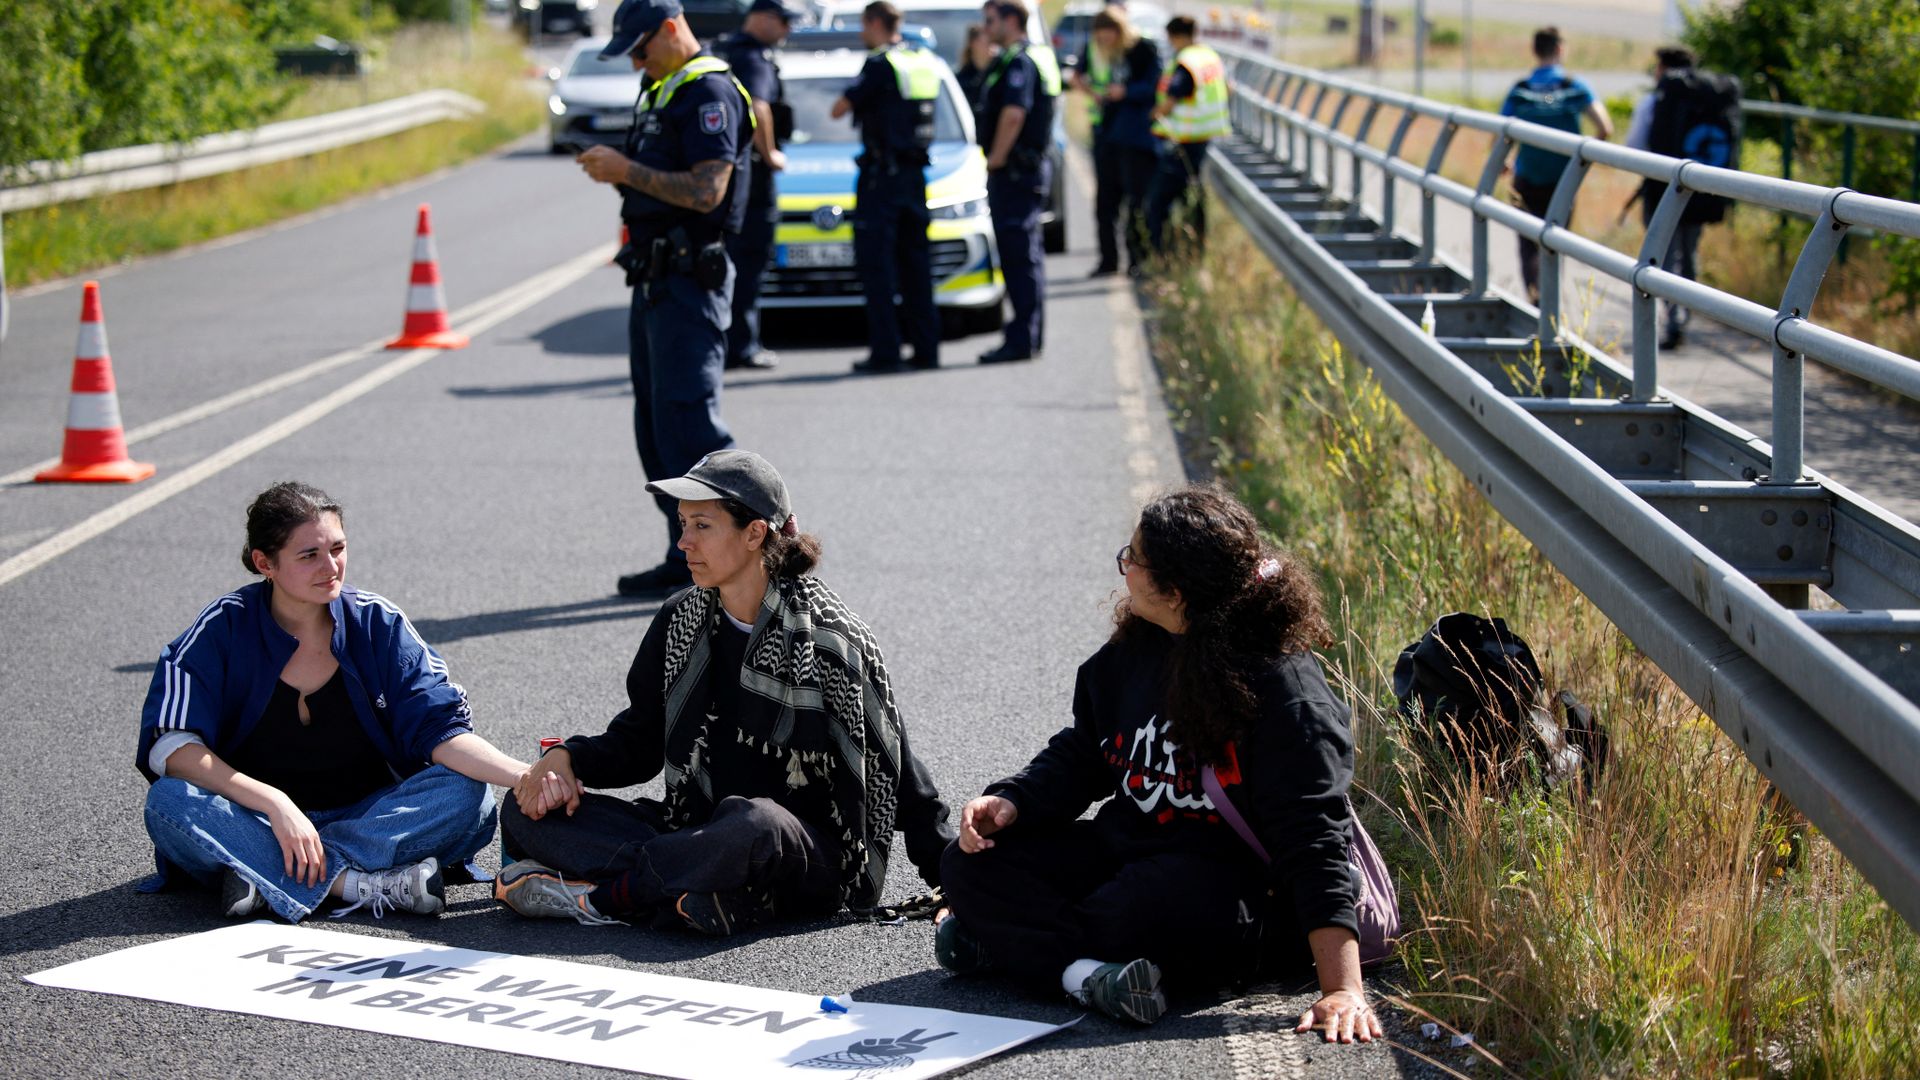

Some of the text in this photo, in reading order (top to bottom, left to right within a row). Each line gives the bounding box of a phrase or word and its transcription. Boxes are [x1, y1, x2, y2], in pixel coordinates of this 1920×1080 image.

[237, 944, 819, 1034] KEINE WAFFEN
[253, 976, 650, 1041] IN BERLIN
